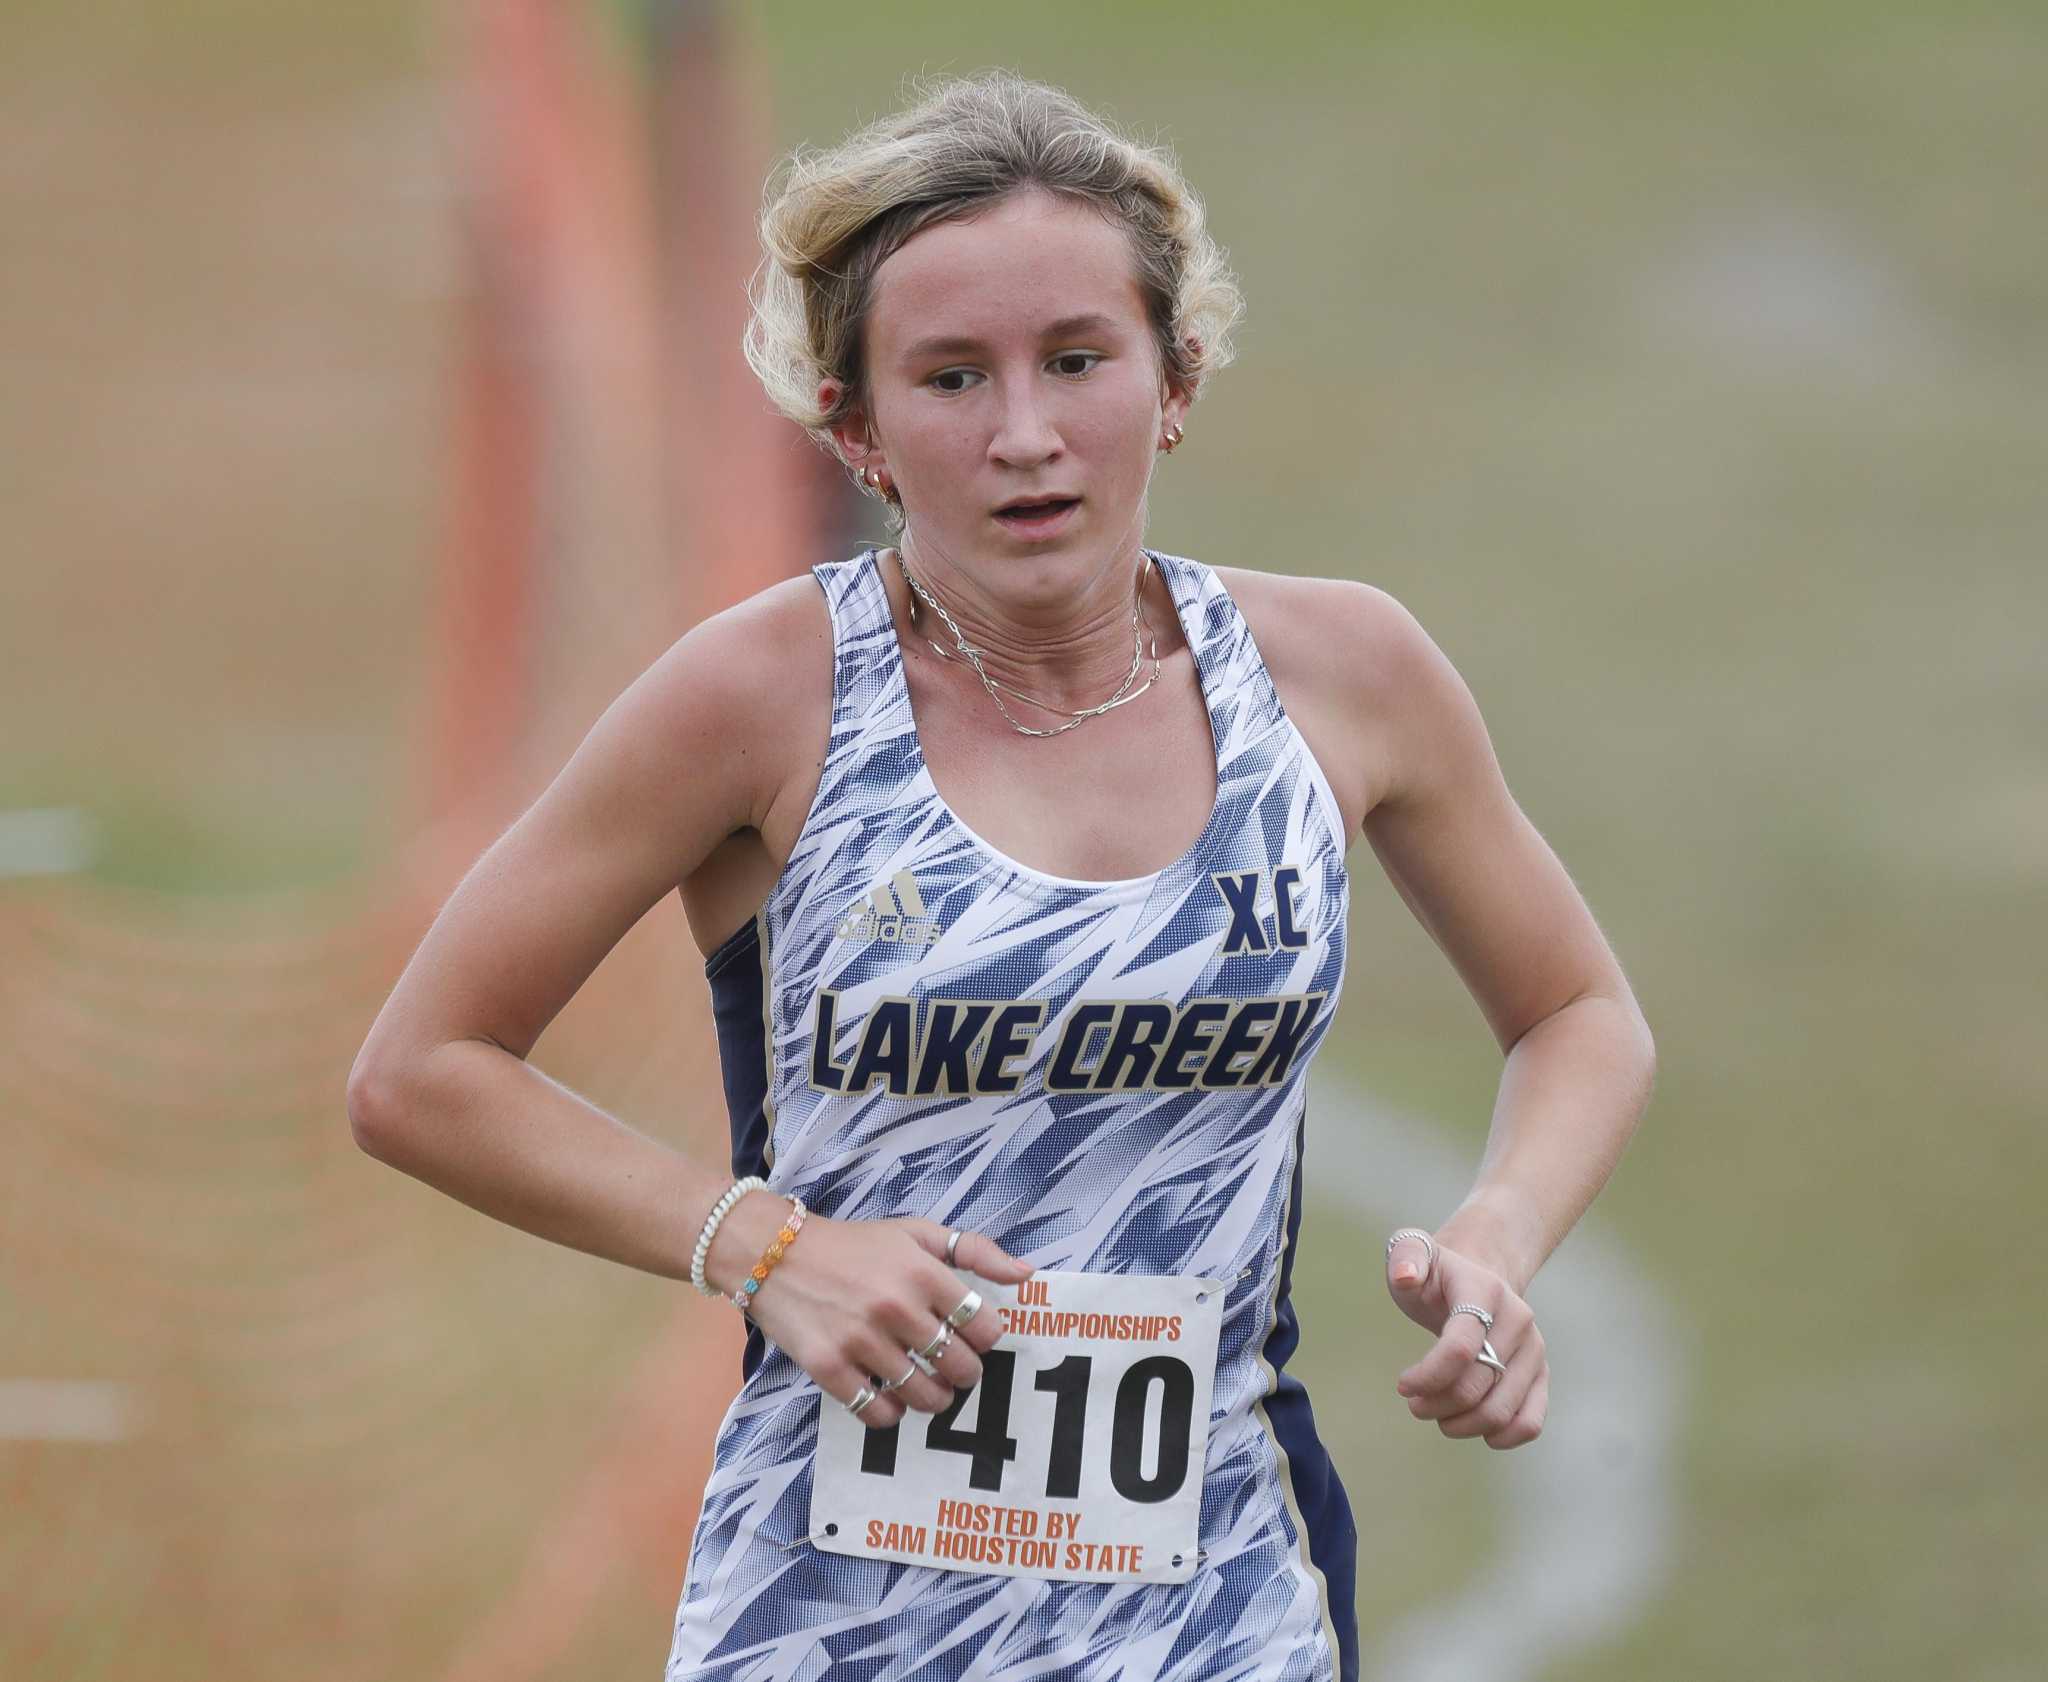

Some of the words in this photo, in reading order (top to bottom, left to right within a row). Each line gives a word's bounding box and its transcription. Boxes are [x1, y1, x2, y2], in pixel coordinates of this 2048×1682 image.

[836, 913, 942, 946] adidas
[1211, 864, 1310, 956] XC
[807, 988, 1049, 1097] LAKE
[1042, 990, 1328, 1095] CREEK
[1017, 1280, 1052, 1307] UIL
[936, 1499, 1039, 1538] HOSTED
[1046, 1511, 1082, 1540] BY
[865, 1519, 927, 1555] SAM
[932, 1529, 1057, 1569] HOUSTON
[1064, 1543, 1145, 1574] STATE
